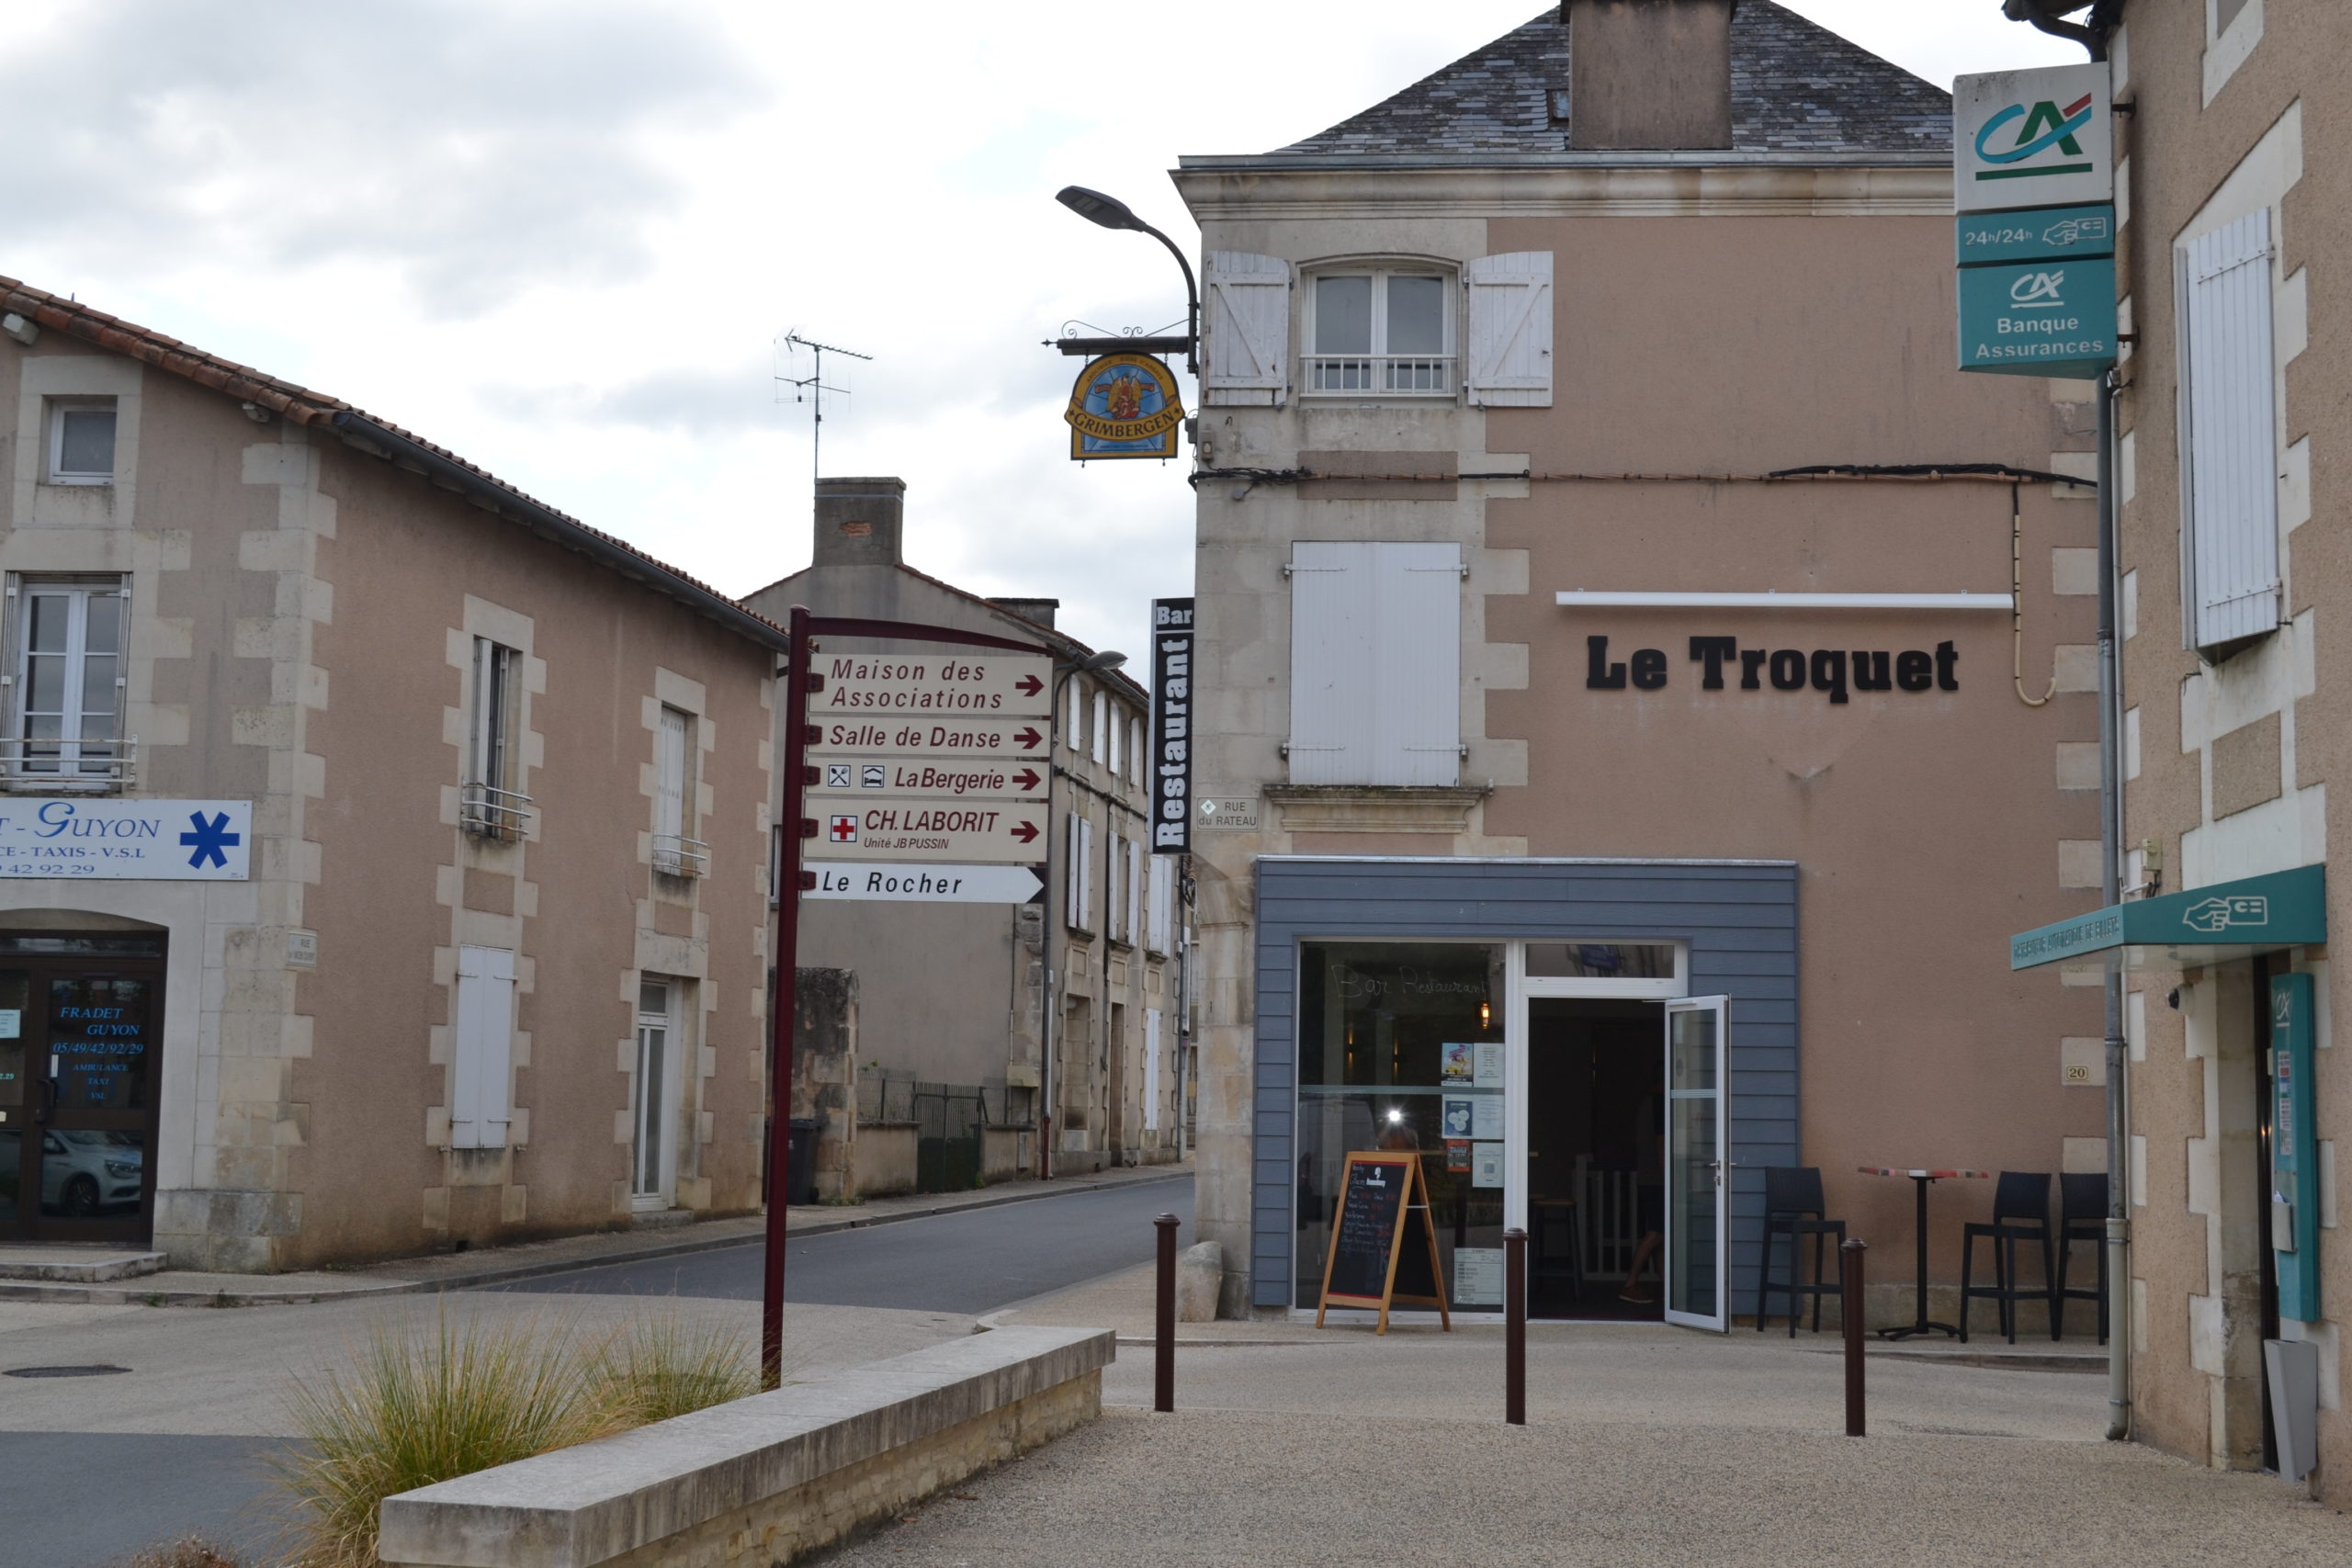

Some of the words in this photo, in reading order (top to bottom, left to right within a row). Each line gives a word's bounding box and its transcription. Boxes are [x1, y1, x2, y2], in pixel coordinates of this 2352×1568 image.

[1965, 229, 2033, 245] 24h/24h
[1996, 316, 2079, 335] Banque
[1975, 339, 2104, 359] Assurances
[1074, 410, 1175, 437] GRIMBERGEN
[1156, 605, 1193, 625] Bar
[831, 659, 925, 681] Maison
[942, 660, 985, 681] des
[1586, 635, 1668, 691] Le
[1689, 636, 1959, 705] Troquet
[831, 686, 1002, 709] Associations
[830, 725, 886, 746] Salle
[896, 727, 922, 747] de
[930, 727, 1001, 748] Danse
[1156, 638, 1189, 847] Restaurant
[1225, 802, 1246, 812] RUE
[34, 801, 162, 838] GUYON
[865, 809, 898, 830] CH.
[903, 811, 1000, 832] LABORIT
[1199, 816, 1212, 826] du
[1216, 816, 1257, 826] RATEAU
[31, 847, 85, 858] TAXIS
[864, 837, 891, 849] Unité
[8, 864, 32, 874] 42
[40, 864, 63, 874] 92
[71, 864, 95, 874] 29
[822, 871, 849, 892] Le
[866, 872, 962, 894] Rocher
[1331, 964, 1392, 998] Bar
[60, 1007, 123, 1019] FRADET
[87, 1024, 140, 1036] GUYON
[52, 1042, 144, 1055] 05/49/42/92/29
[2069, 1067, 2086, 1078] 20
